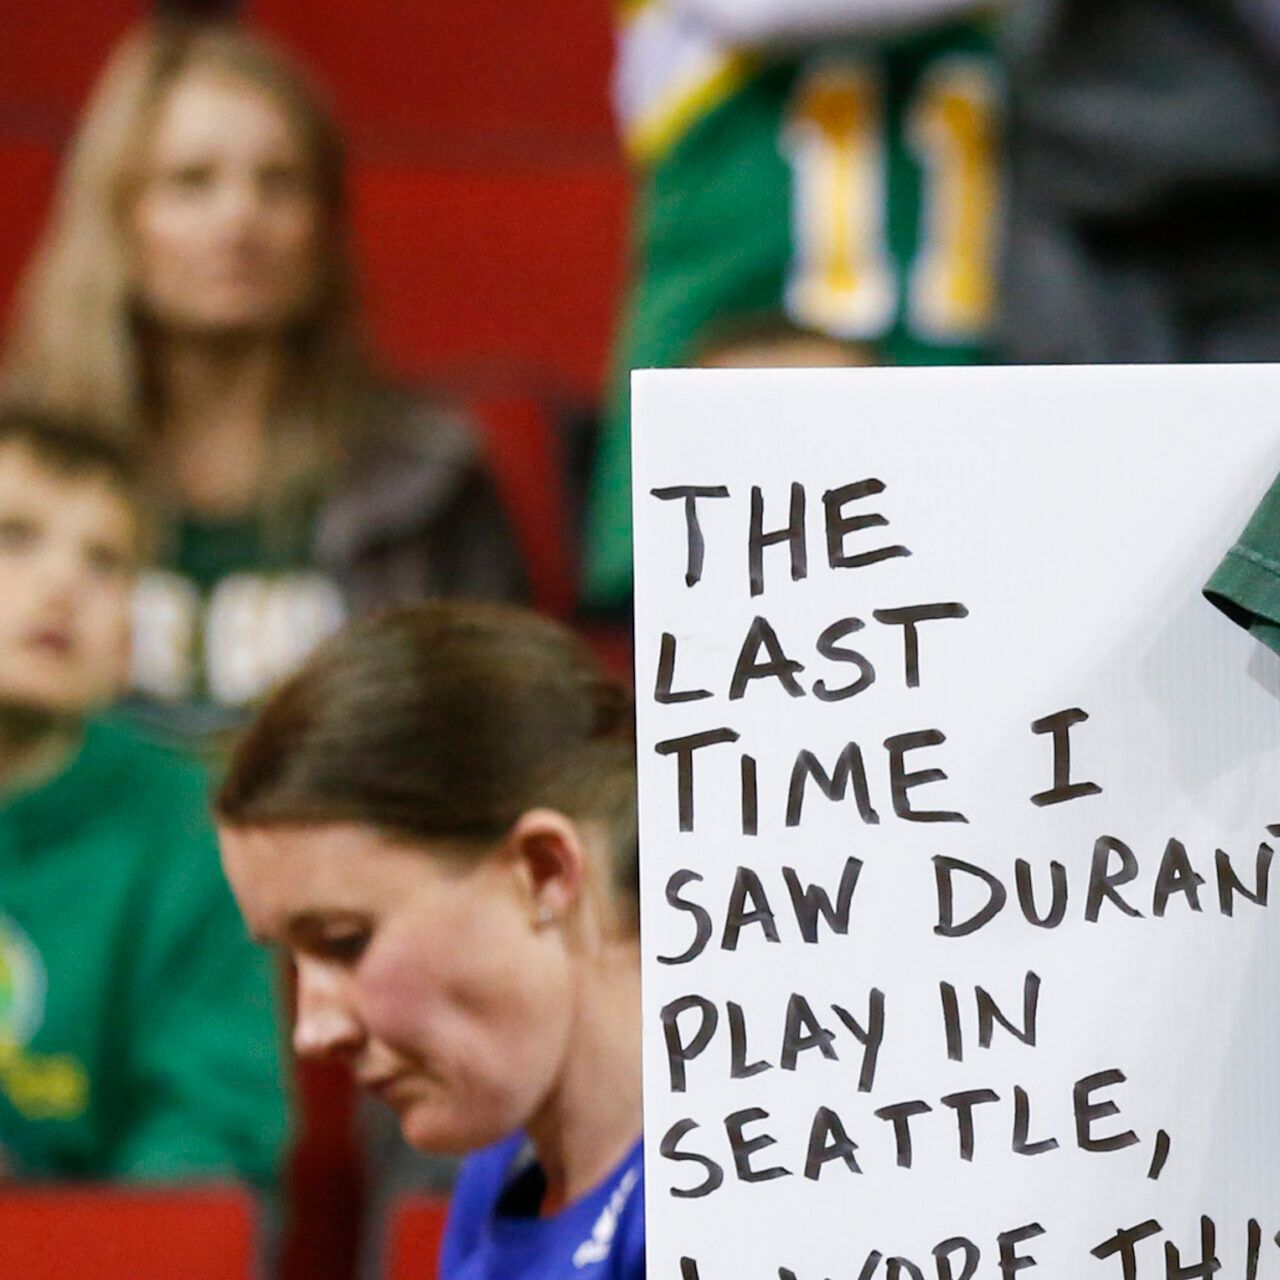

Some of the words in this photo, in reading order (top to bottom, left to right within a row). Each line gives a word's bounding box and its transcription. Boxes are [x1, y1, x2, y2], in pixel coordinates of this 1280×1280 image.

[650, 478, 911, 597] THE
[655, 603, 968, 704] LAST
[655, 728, 969, 836] TIME
[1031, 708, 1102, 807] I
[657, 857, 863, 965] SAW
[661, 988, 884, 1092] PLAY
[940, 971, 1040, 1061] IN
[661, 1069, 1171, 1198] SEATTLE,
